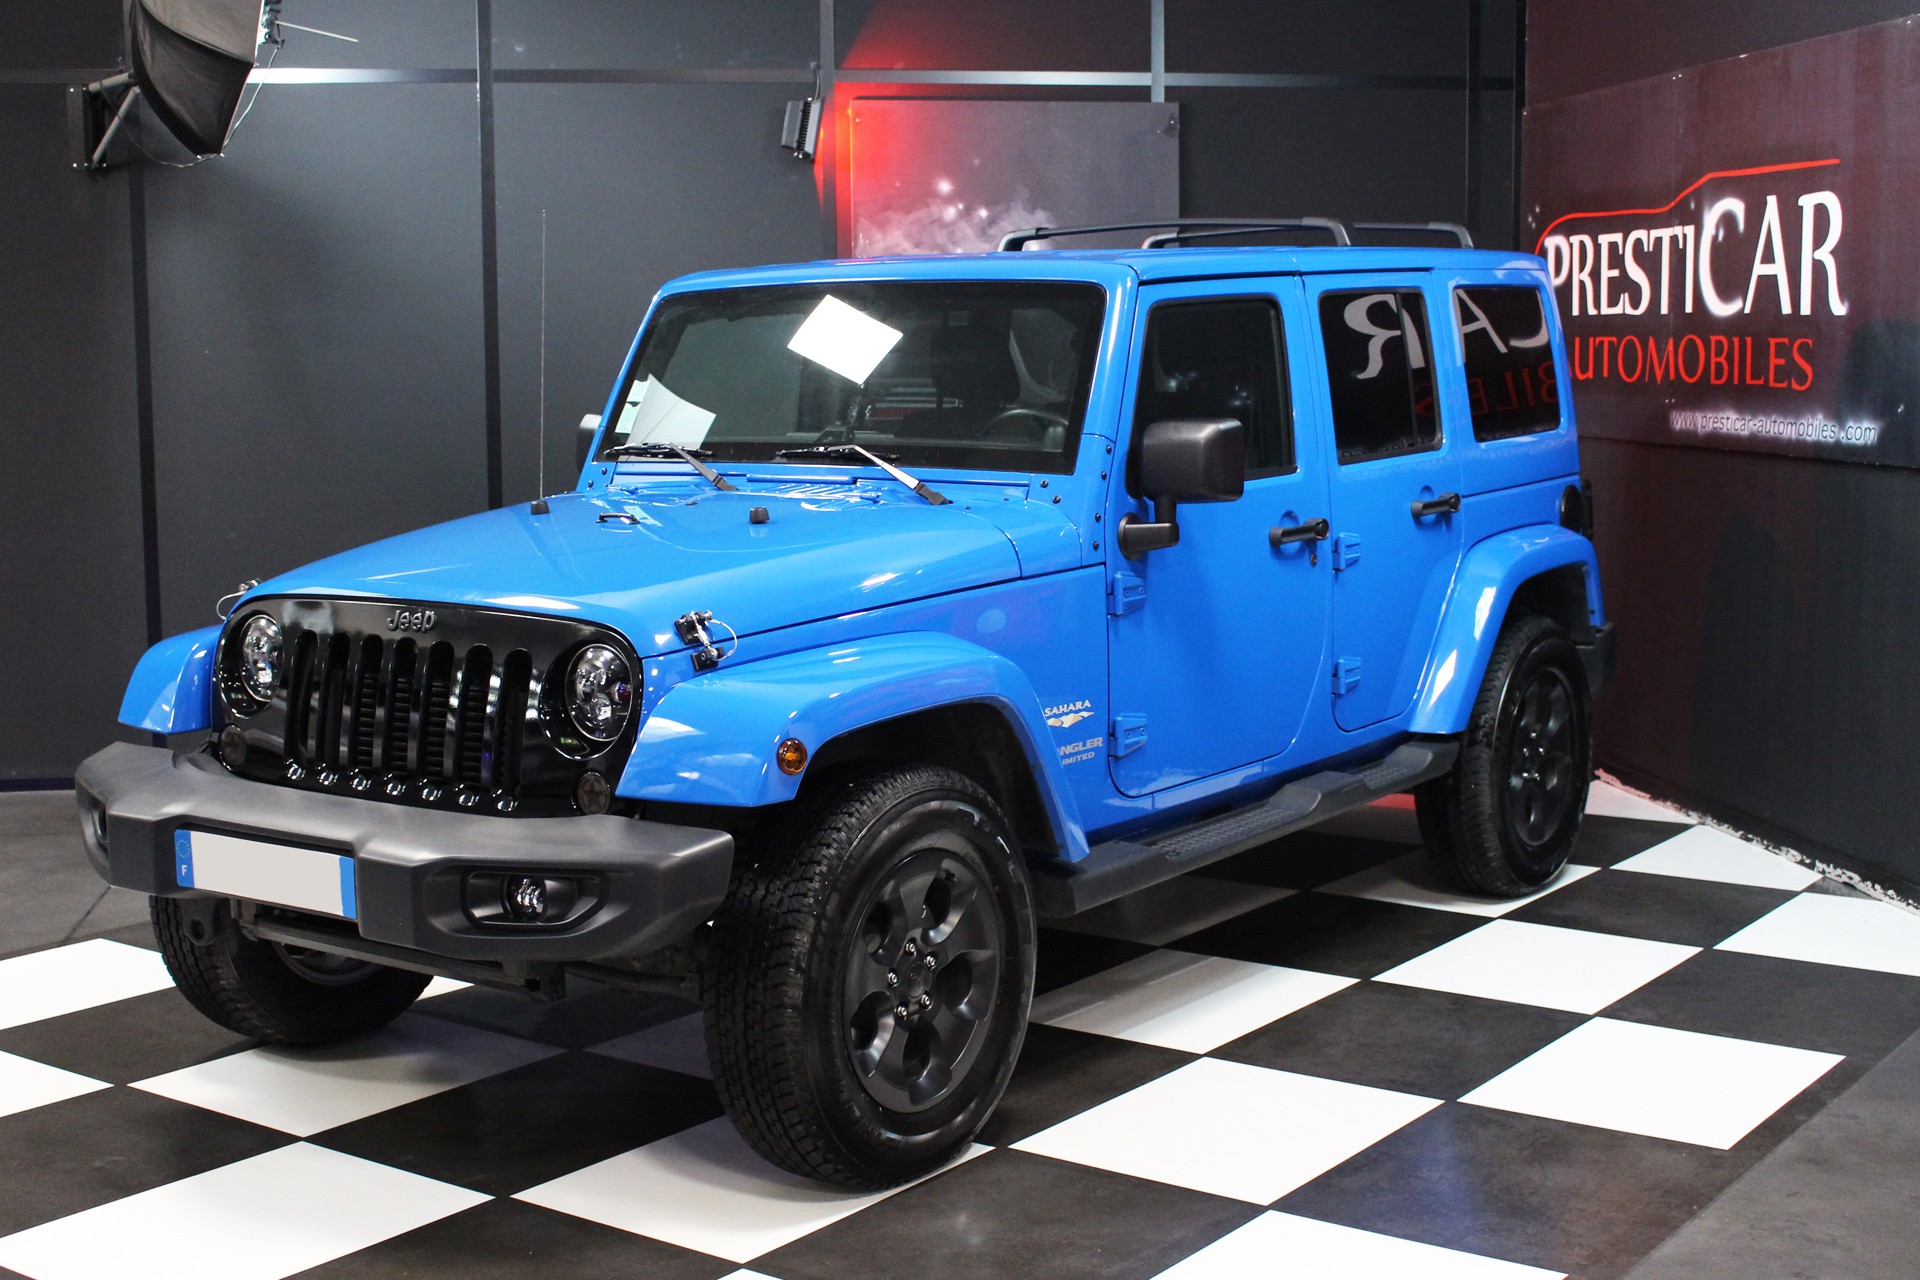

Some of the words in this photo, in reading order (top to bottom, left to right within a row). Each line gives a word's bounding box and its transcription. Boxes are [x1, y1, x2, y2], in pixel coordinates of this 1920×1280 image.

[1568, 335, 1814, 391] UTOMOBILES
[387, 609, 437, 632] Jeep
[1044, 700, 1092, 717] SAHARA
[1057, 737, 1104, 756] NGLER
[181, 865, 188, 876] F
